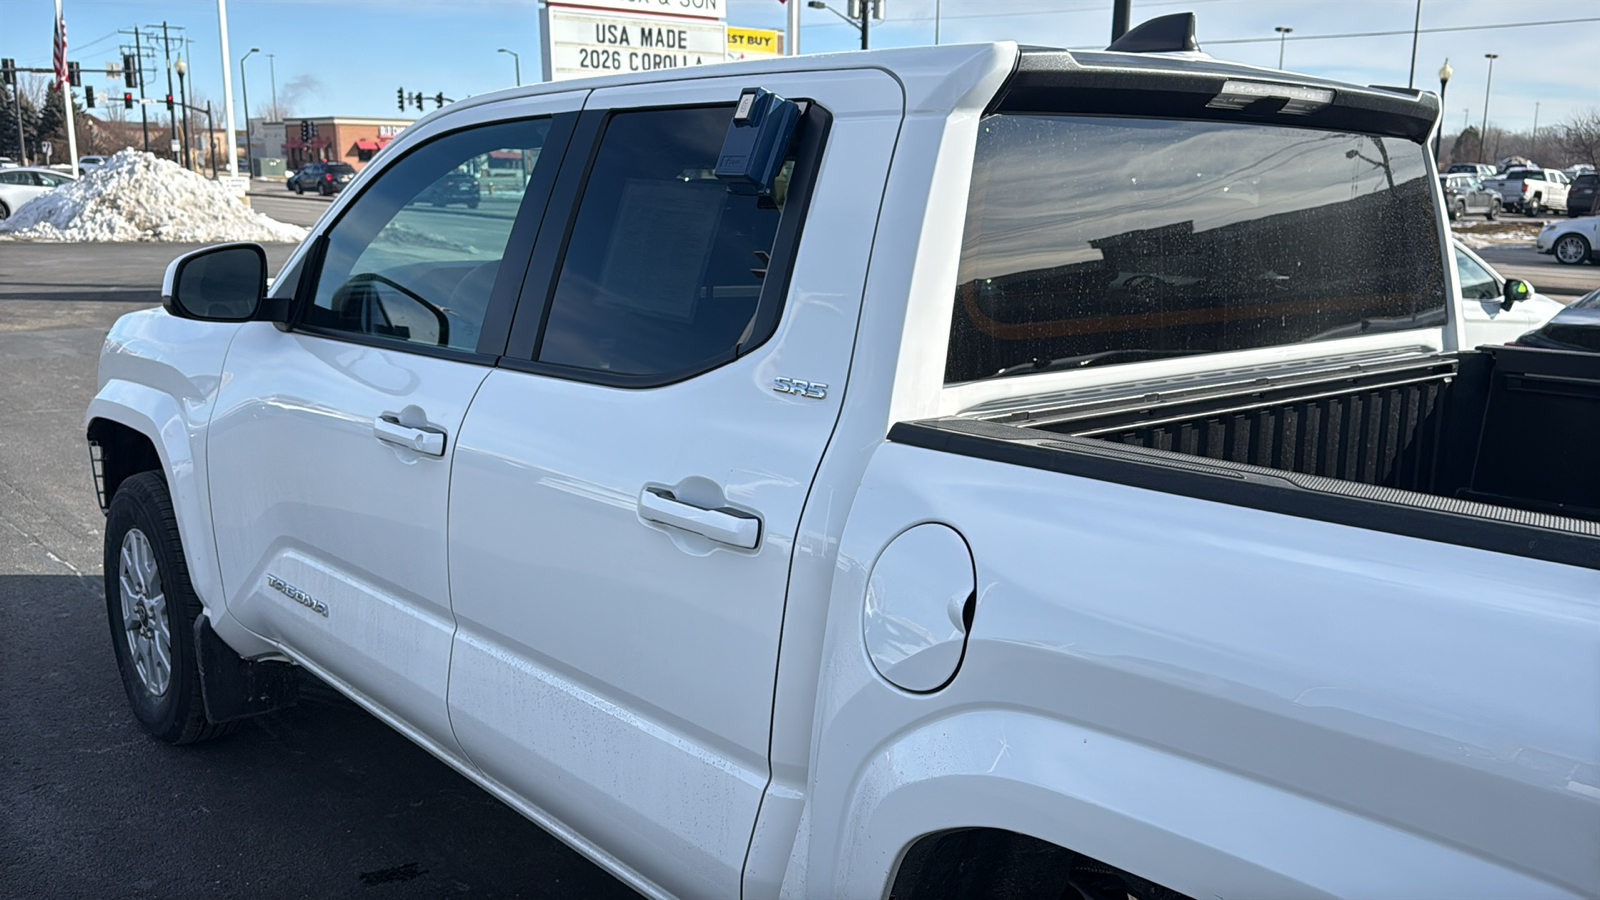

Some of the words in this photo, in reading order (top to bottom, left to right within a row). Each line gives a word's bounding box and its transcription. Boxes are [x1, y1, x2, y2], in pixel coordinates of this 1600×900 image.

[596, 24, 630, 46] USA
[640, 27, 688, 49] MADE
[747, 36, 771, 46] BUY
[579, 48, 621, 70] 2026
[773, 376, 828, 400] SR5
[267, 573, 329, 618] TACOMA
